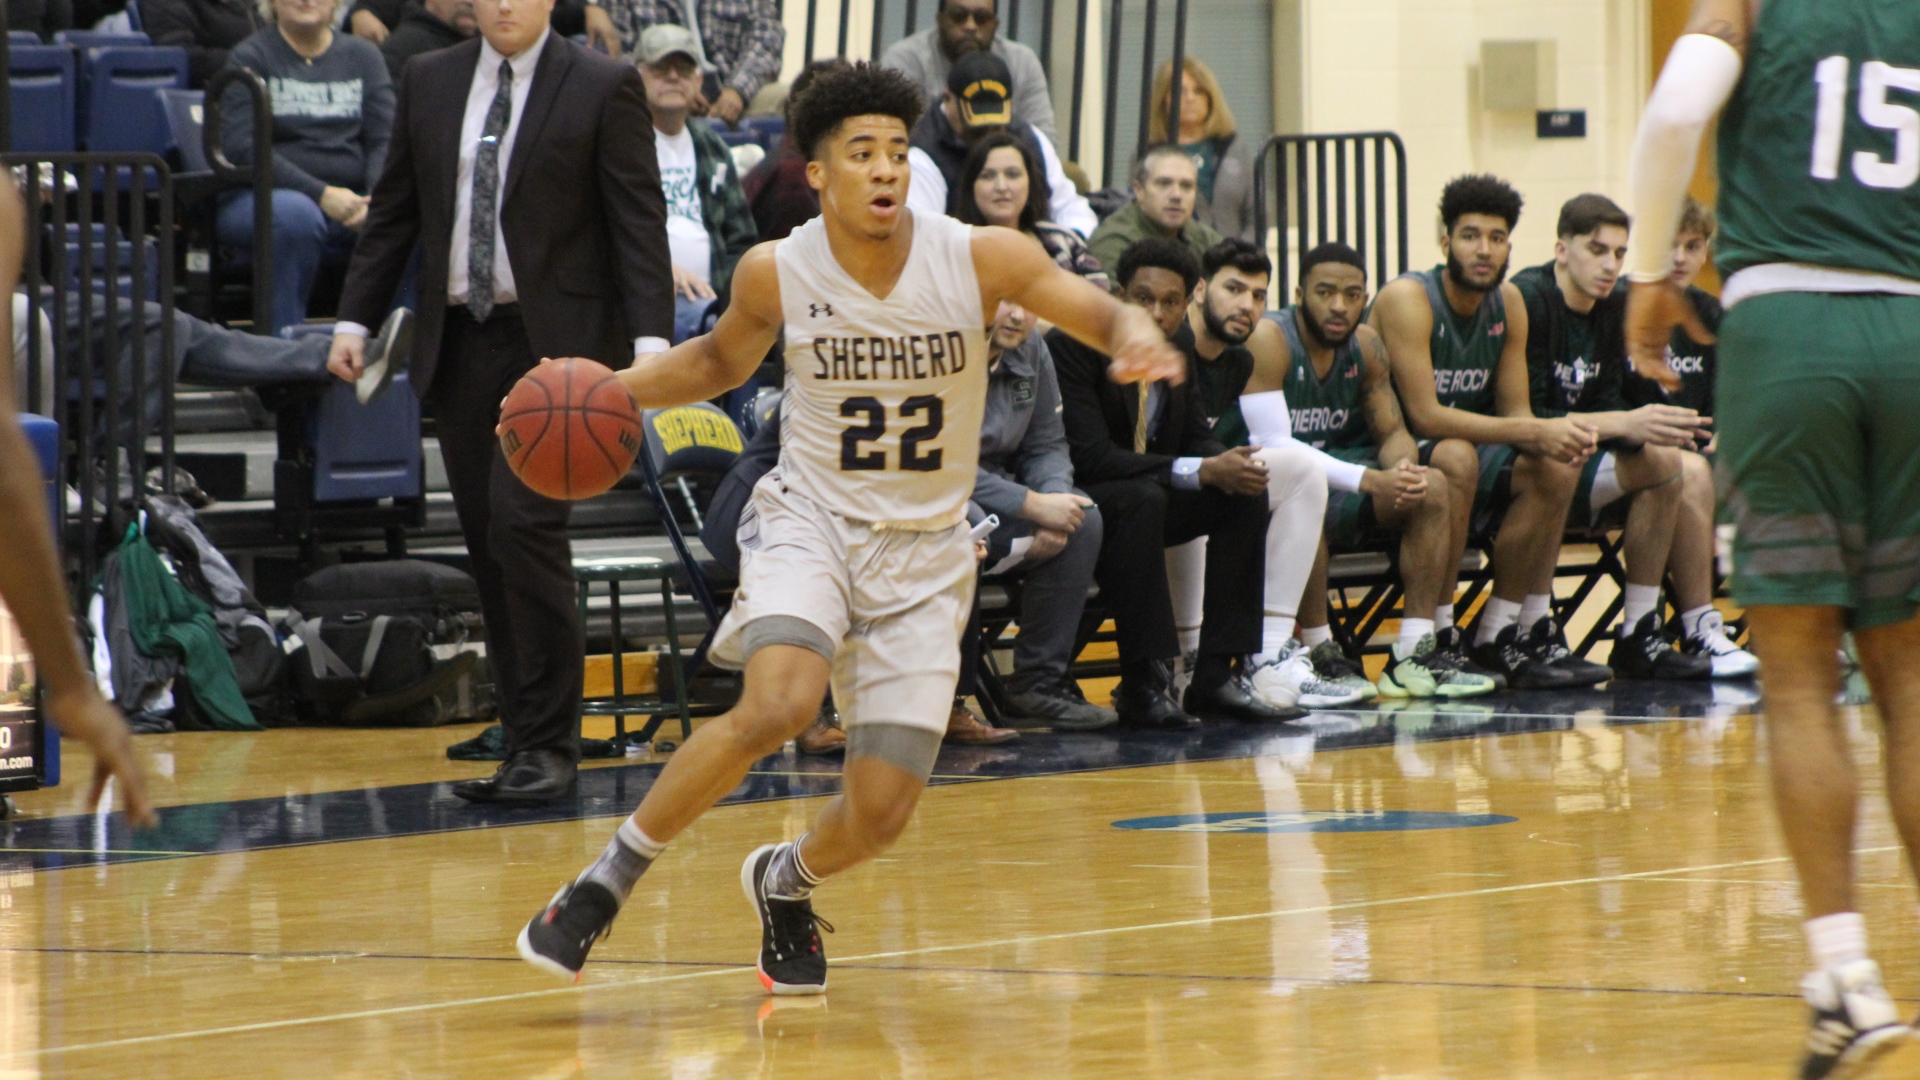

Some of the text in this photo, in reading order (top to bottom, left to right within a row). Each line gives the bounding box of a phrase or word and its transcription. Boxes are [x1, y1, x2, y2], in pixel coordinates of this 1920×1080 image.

[1810, 55, 1920, 189] 15
[813, 330, 966, 380] SHEPHERD
[653, 407, 744, 455] SHEPHERD
[839, 394, 944, 472] 22
